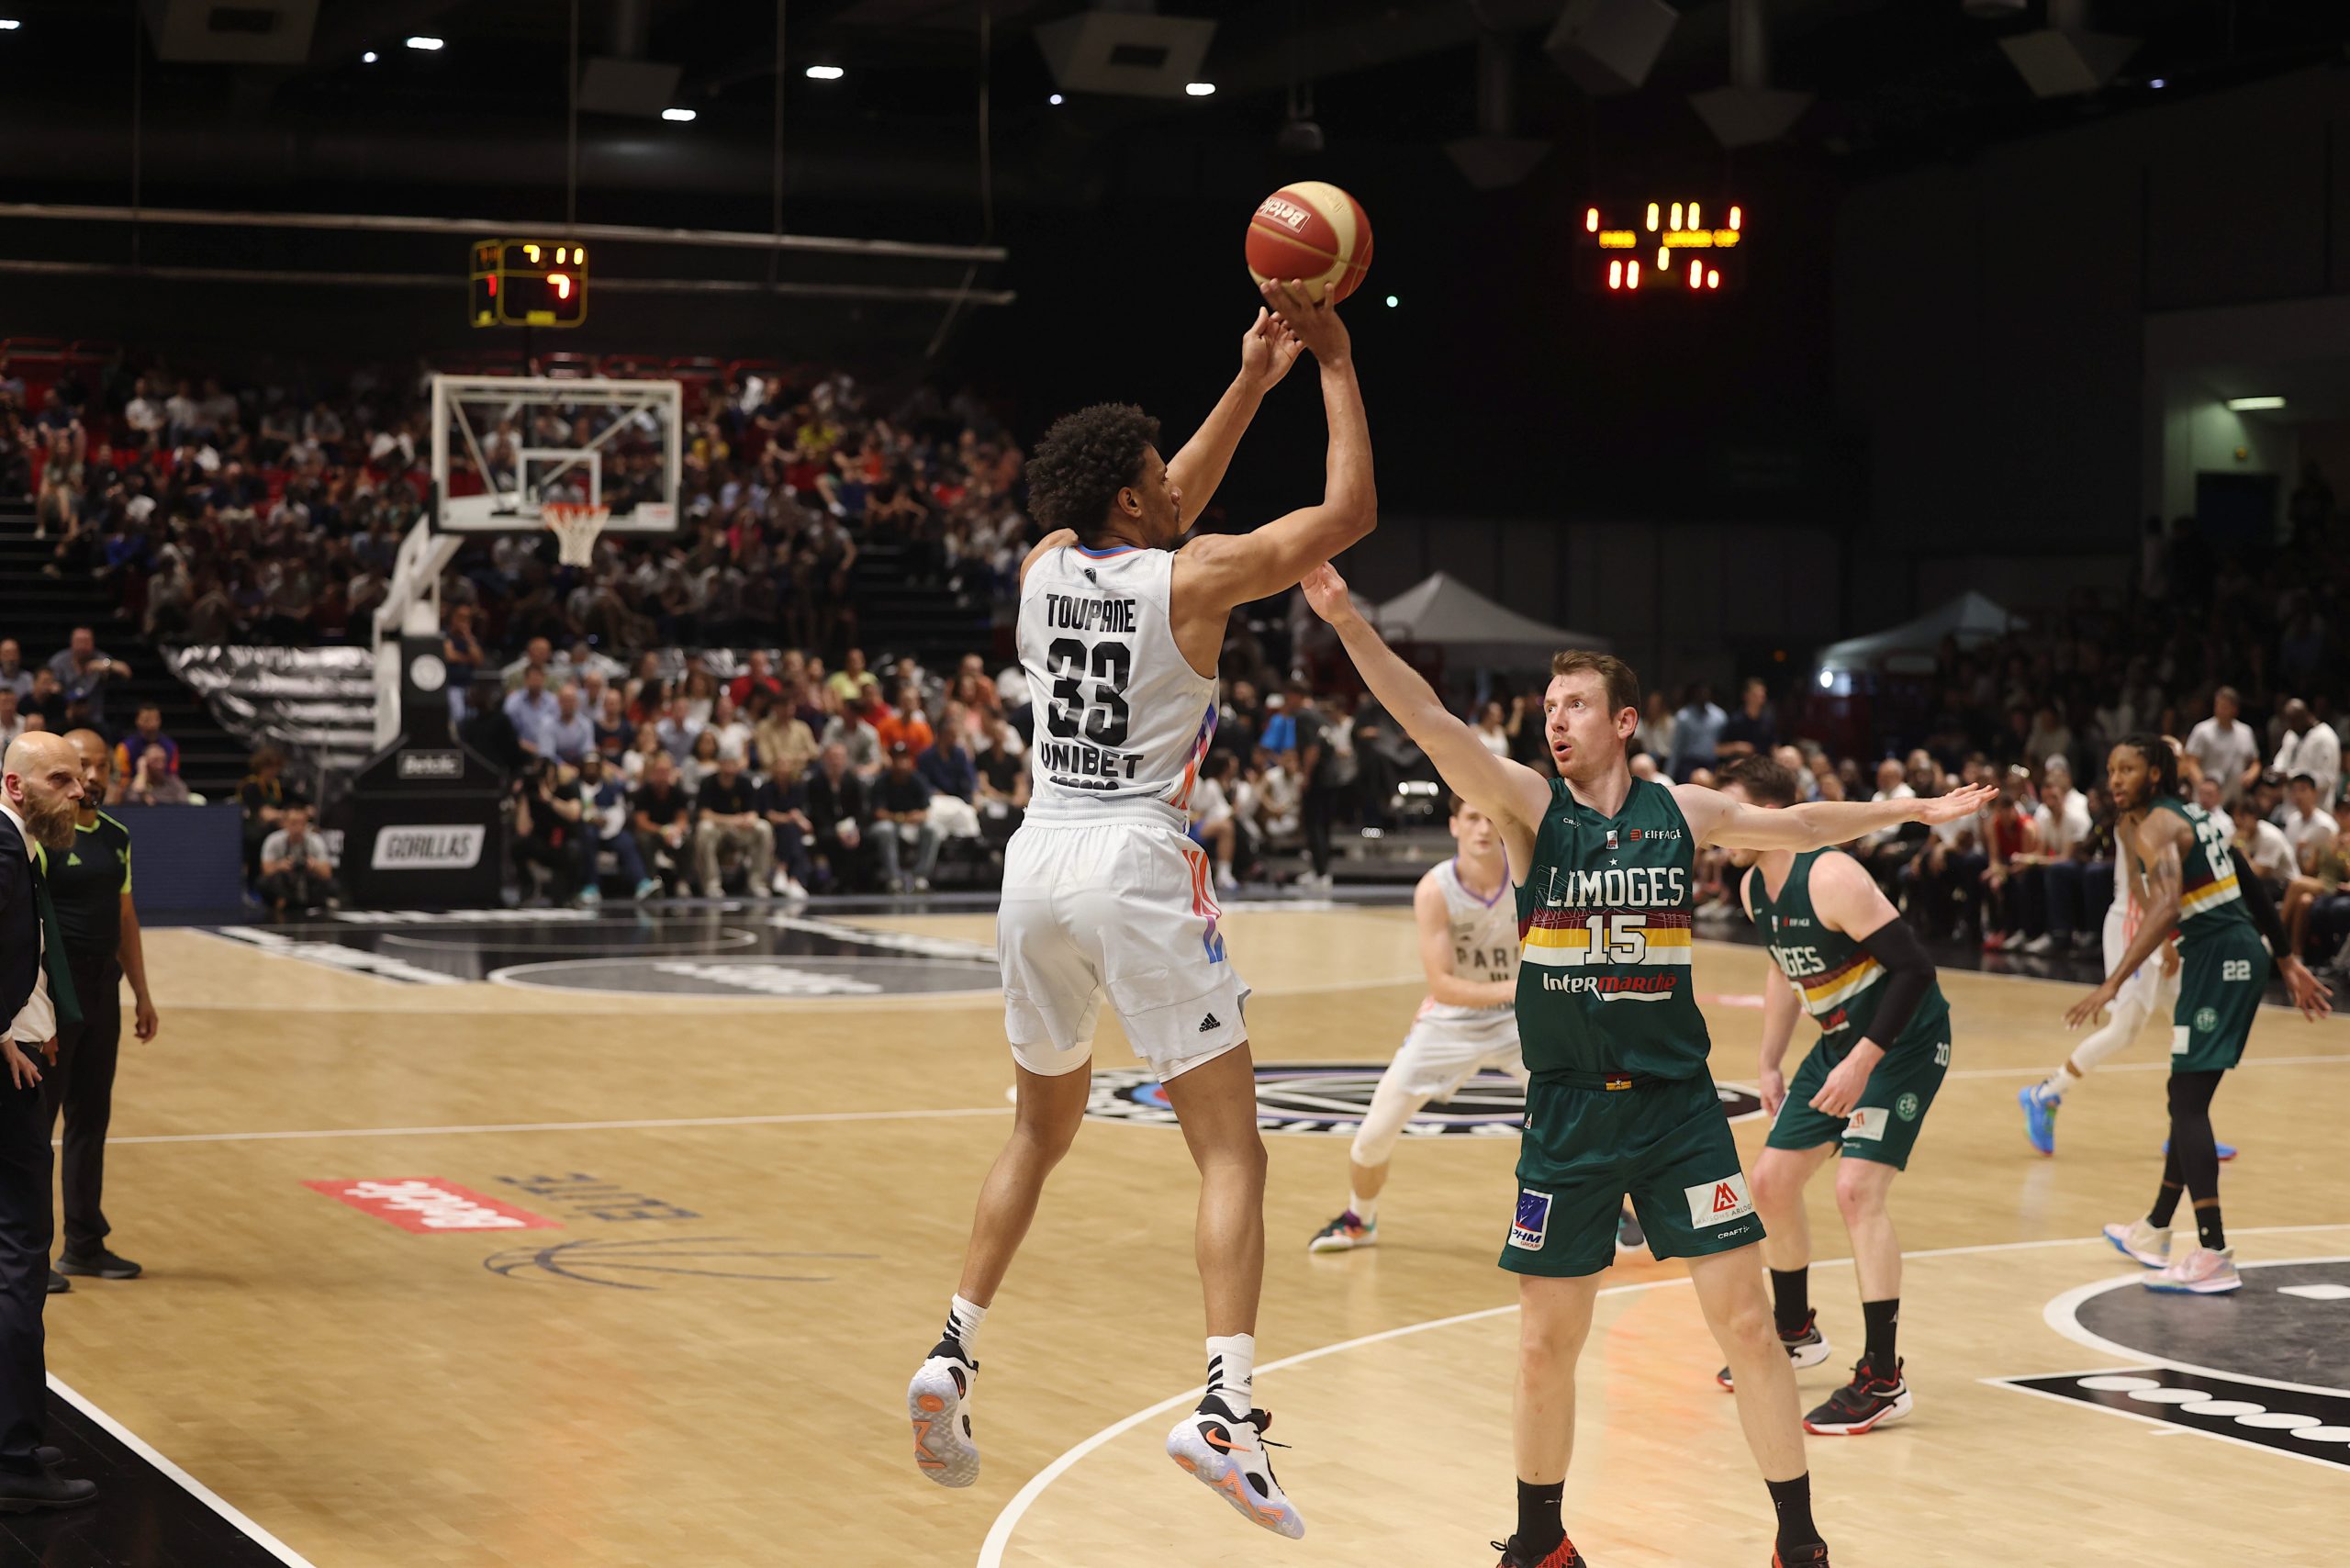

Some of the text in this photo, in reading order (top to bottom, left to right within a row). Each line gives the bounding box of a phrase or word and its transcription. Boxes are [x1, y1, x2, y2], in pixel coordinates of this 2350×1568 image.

[1046, 593, 1136, 633] TOUPANE
[1046, 637, 1131, 747] 33
[1040, 741, 1145, 779] UNIBET
[386, 833, 474, 860] GORILLAS
[1644, 828, 1683, 840] EIFFAGE
[1546, 866, 1685, 907] LIMOGES
[1583, 914, 1647, 965] 15
[1455, 946, 1519, 969] PARI
[2222, 960, 2251, 981] 22
[1199, 1021, 1221, 1033] adidas
[1934, 1042, 1950, 1067] 10
[1731, 1202, 1752, 1215] ARLOG
[1718, 1227, 1743, 1239] CRAFT
